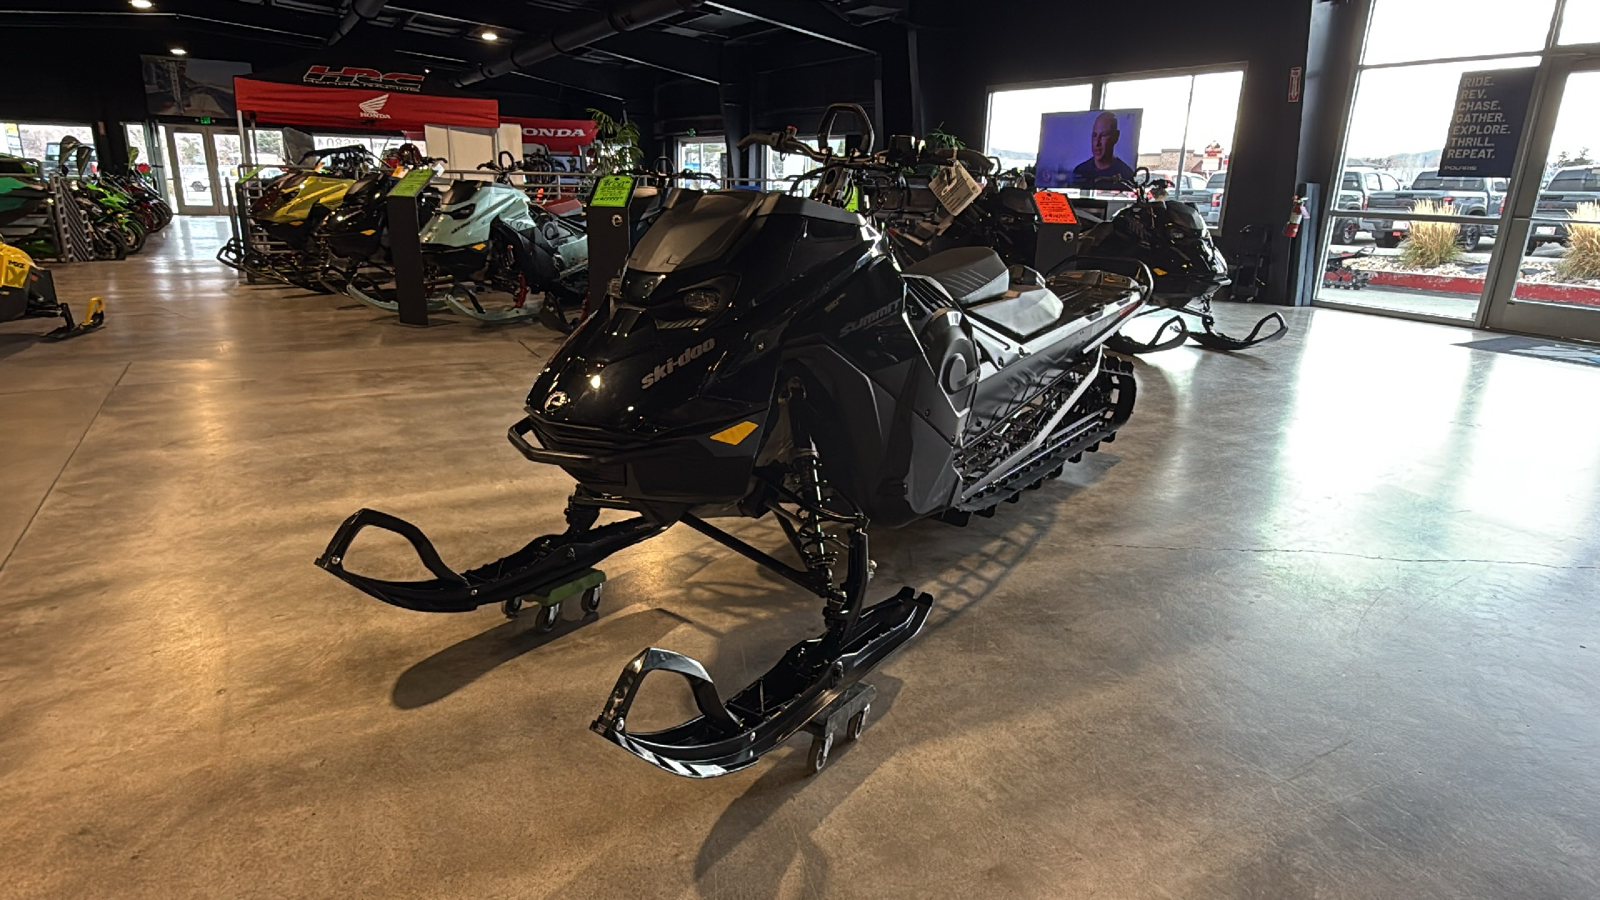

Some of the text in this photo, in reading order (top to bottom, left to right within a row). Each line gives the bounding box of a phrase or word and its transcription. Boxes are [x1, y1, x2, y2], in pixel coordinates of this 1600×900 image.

[1463, 76, 1494, 88] RIDE.
[1461, 89, 1487, 99] REV.
[1458, 100, 1501, 111] CHASE.
[1456, 112, 1506, 123] GATHER.
[522, 127, 586, 137] ONDA
[1452, 124, 1511, 135] EXPLORE.
[1451, 137, 1495, 147] THRILL.
[1446, 148, 1495, 159] REPEAT.
[641, 338, 716, 390] ski-doo
